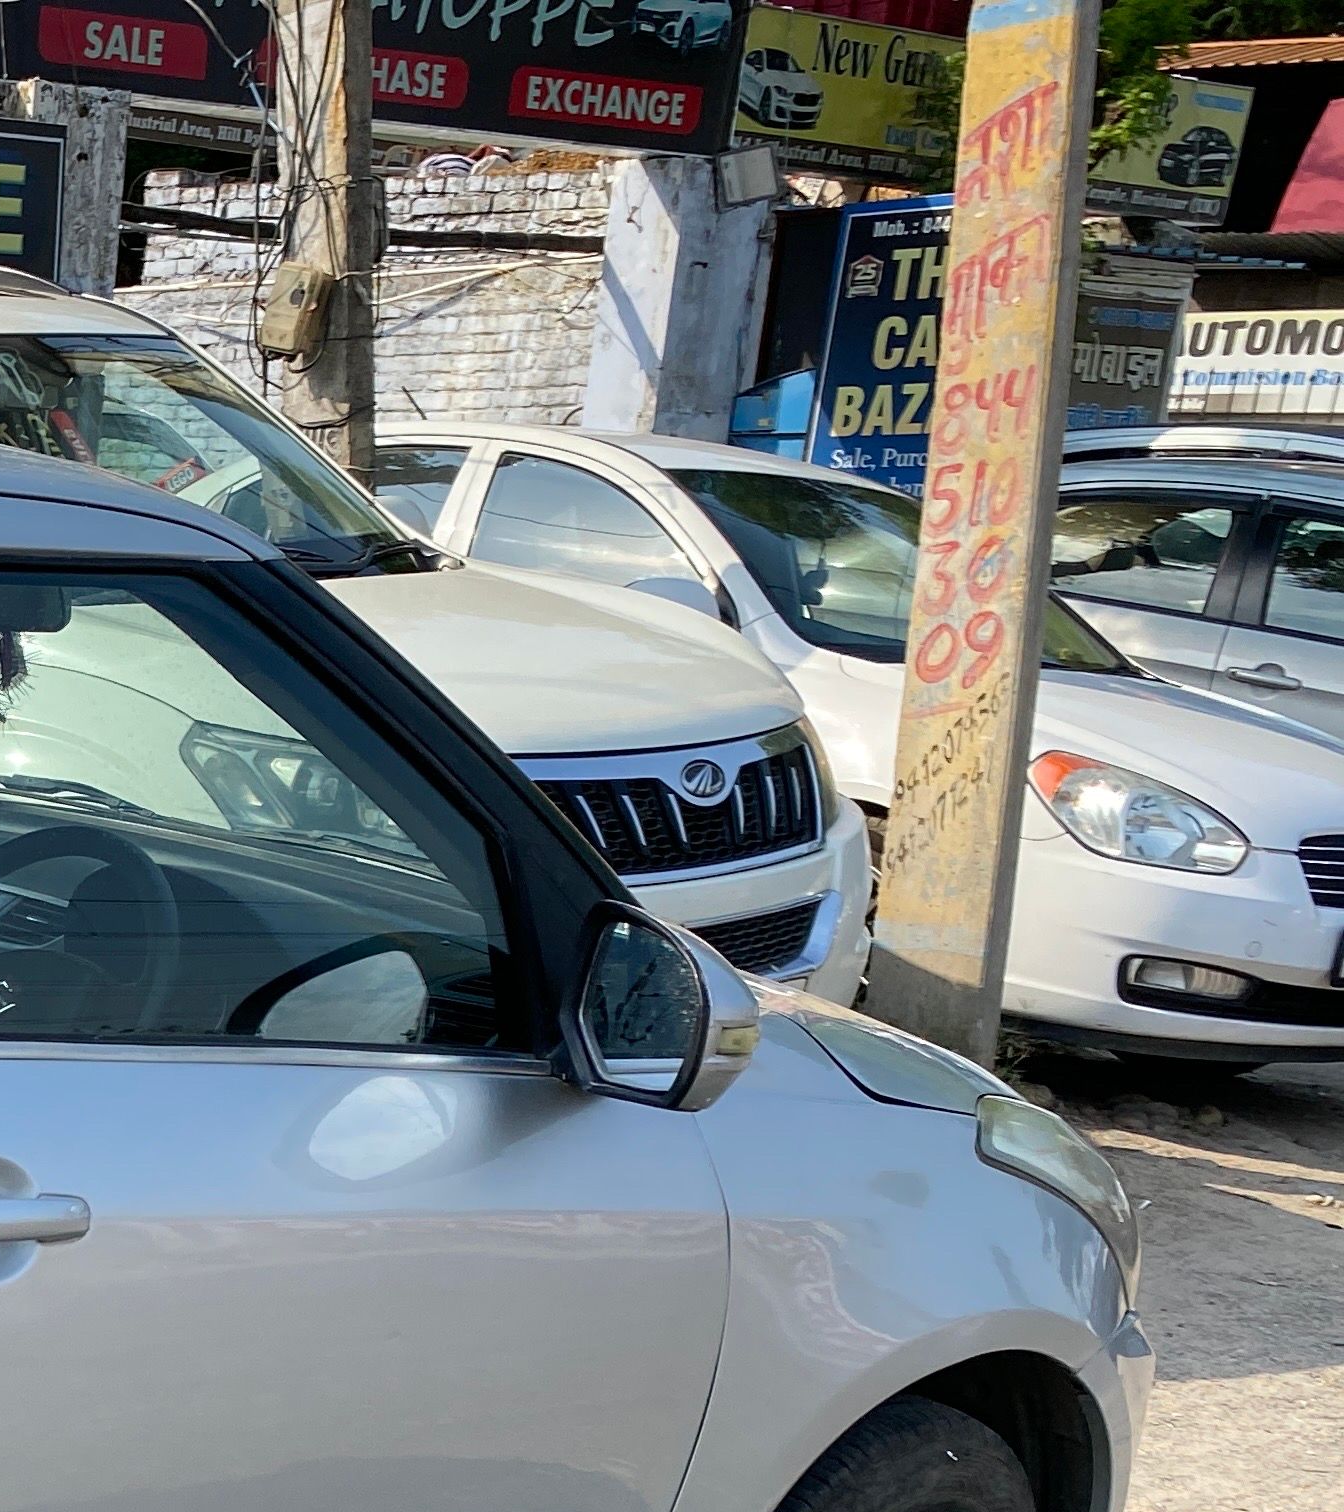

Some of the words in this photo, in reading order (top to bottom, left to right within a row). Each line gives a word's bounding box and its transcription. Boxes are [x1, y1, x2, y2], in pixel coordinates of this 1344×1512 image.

[83, 21, 166, 67] SALE
[812, 22, 880, 80] New
[525, 75, 687, 126] EXCHANGE
[179, 119, 214, 141] Area,
[216, 125, 242, 142] Hill
[873, 221, 909, 237] Mob.
[1183, 368, 1307, 386] Commission
[830, 383, 932, 437] BAZ
[933, 364, 1037, 456] 844
[830, 447, 876, 472] Sale,
[923, 456, 1023, 539] 510
[917, 535, 1011, 617] 36
[915, 610, 1005, 690] 09
